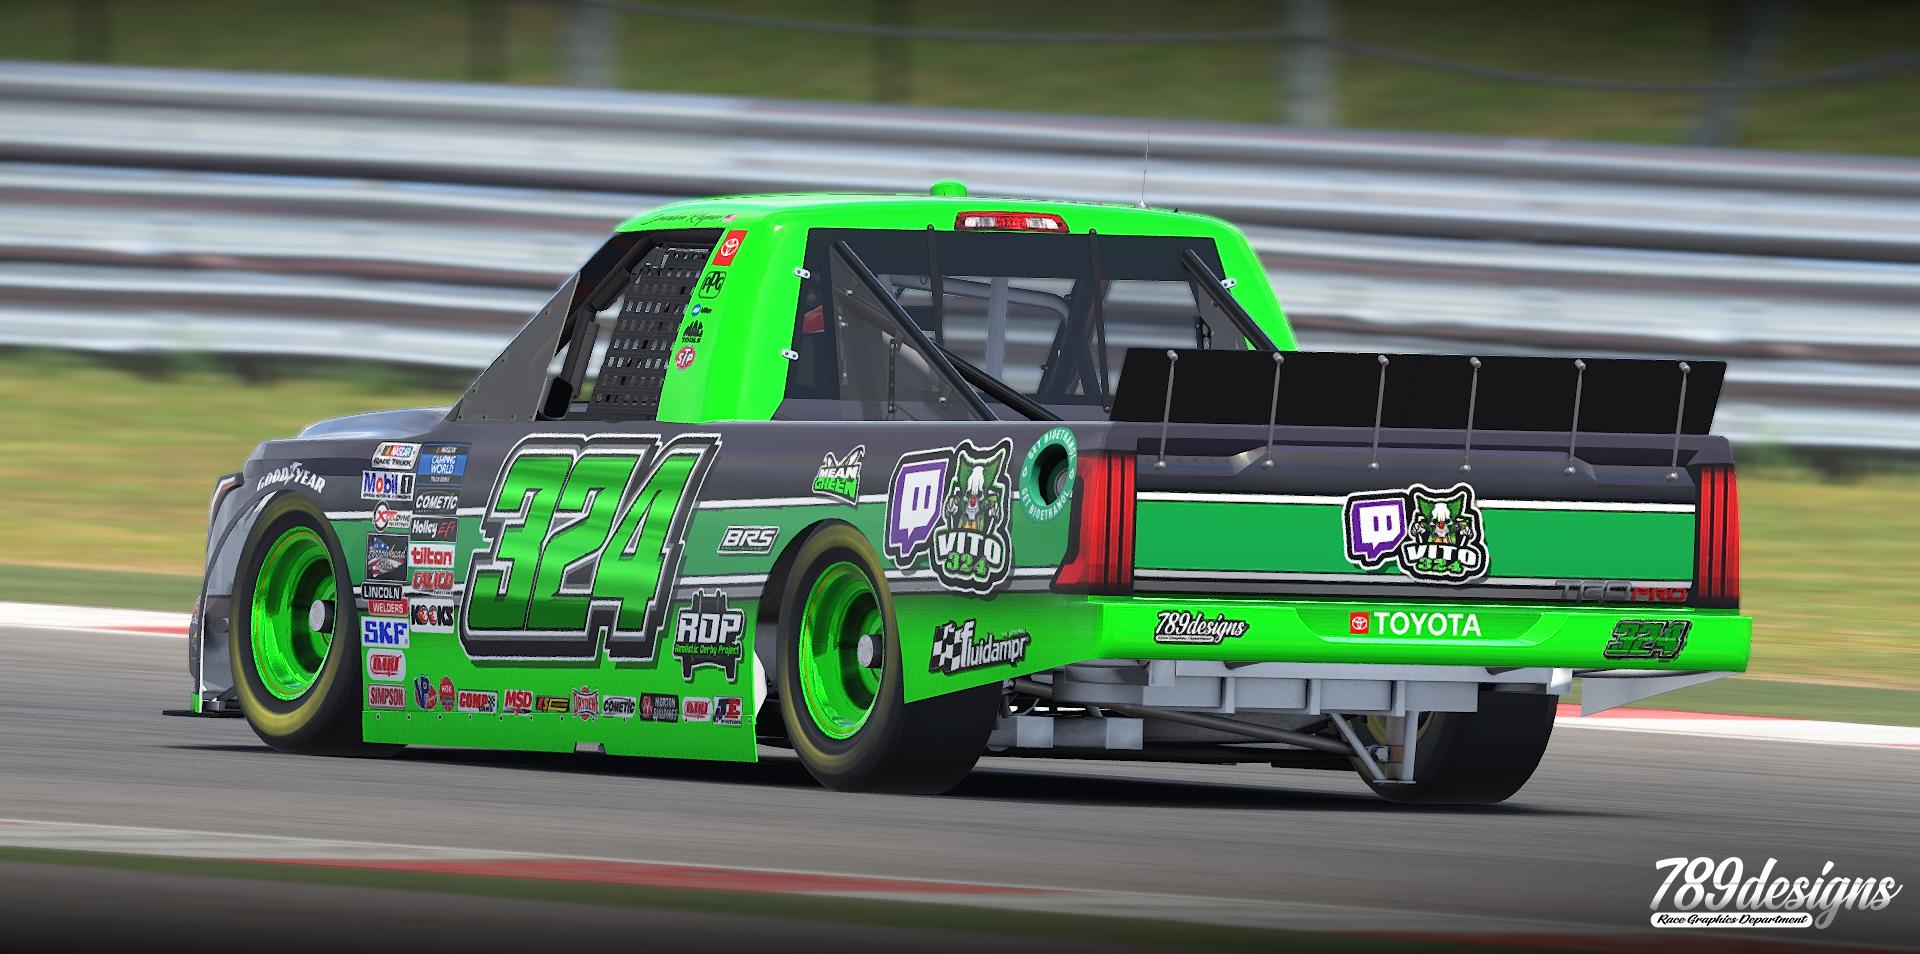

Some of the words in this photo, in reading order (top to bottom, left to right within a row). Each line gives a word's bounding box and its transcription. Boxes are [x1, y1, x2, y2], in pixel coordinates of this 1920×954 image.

[702, 271, 725, 293] PPG
[677, 348, 693, 366] STP
[1028, 439, 1041, 459] GET
[1044, 429, 1077, 460] BIOETHANOL
[257, 461, 326, 493] GOODYEAR
[431, 464, 454, 474] WORLD
[819, 466, 858, 478] MEAN
[364, 472, 398, 494] Mobil
[814, 477, 857, 498] GREEN
[415, 493, 458, 509] COMETIC
[1022, 487, 1031, 507] GET
[1029, 489, 1072, 520] BIOETHANOL
[412, 519, 437, 538] Holley
[722, 529, 776, 547] BRS
[411, 546, 452, 565] tilton
[462, 441, 712, 650] 324
[938, 532, 1001, 564] VITO
[1407, 545, 1477, 566] VITO
[946, 552, 988, 575] 324
[1417, 557, 1462, 573] 324
[364, 586, 400, 600] LINCOLN
[372, 601, 404, 614] WELDERS
[364, 620, 408, 645] SKF
[1156, 612, 1246, 643] 789designs
[1374, 611, 1482, 636] TOYOTA
[699, 644, 717, 656] Derby
[718, 644, 740, 656] Project
[960, 620, 1029, 667] fluidampr
[370, 686, 404, 706] SIMPSON
[459, 692, 488, 708] COMP
[505, 690, 532, 708] MSD
[603, 699, 635, 713] COMETIC
